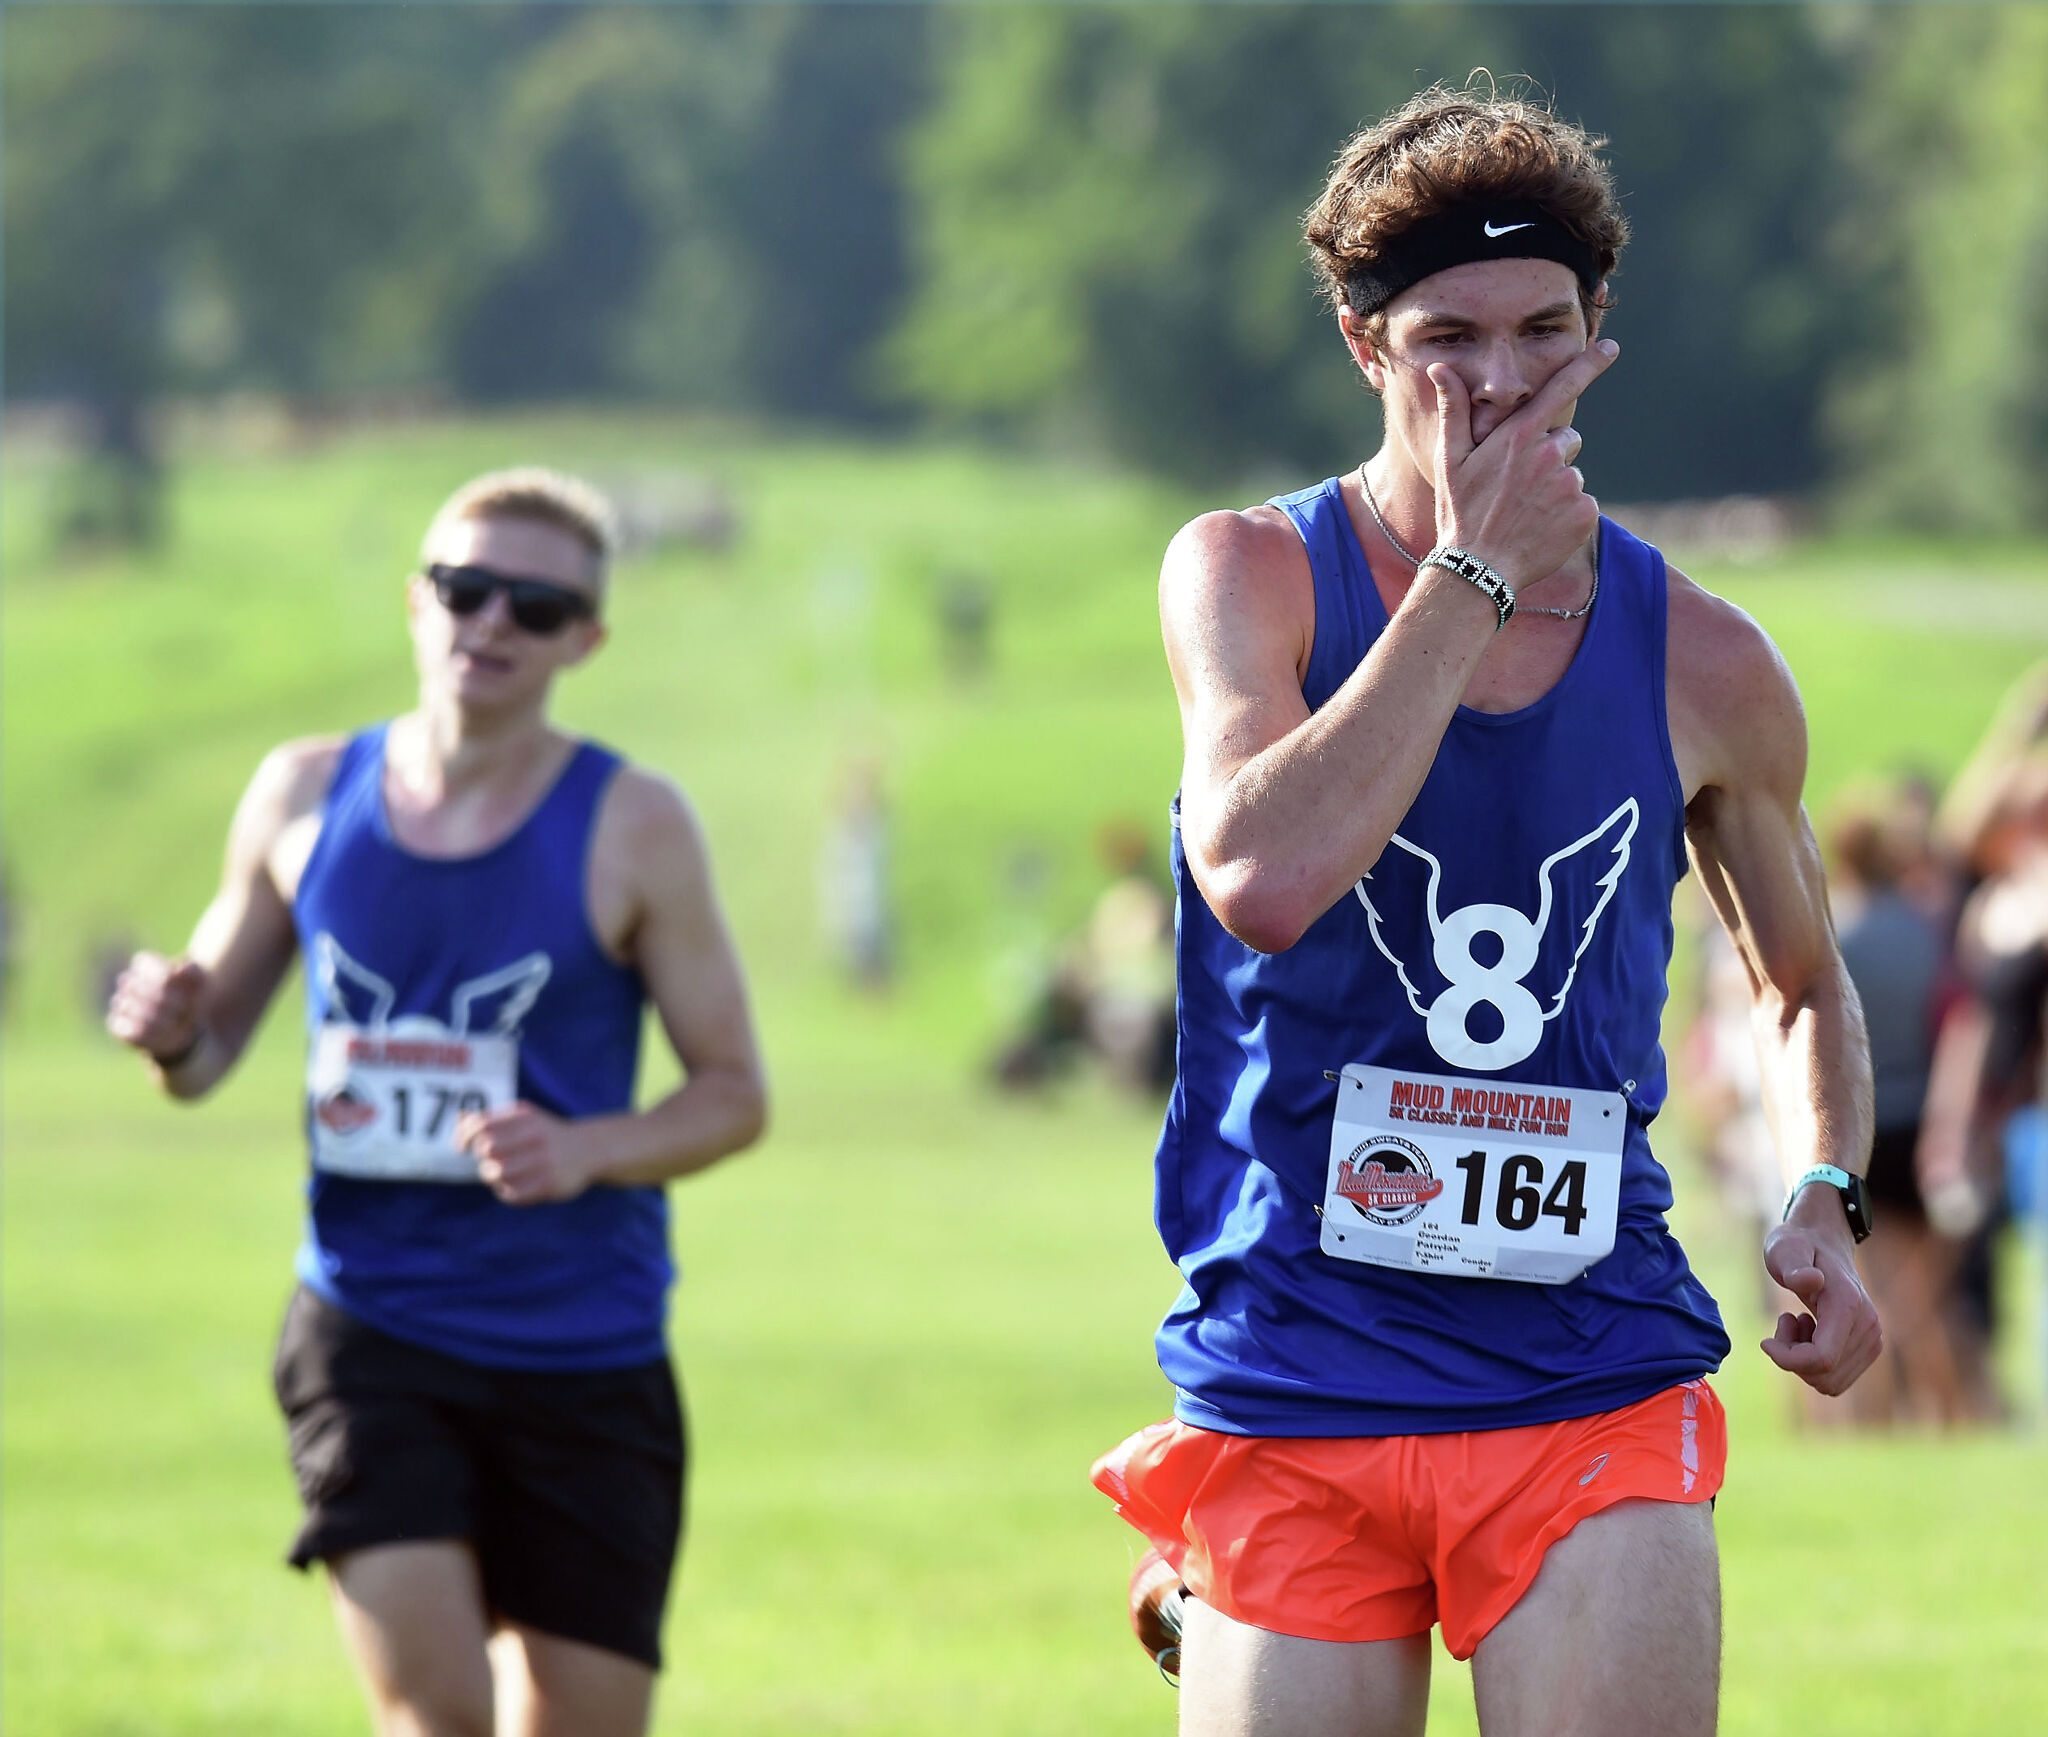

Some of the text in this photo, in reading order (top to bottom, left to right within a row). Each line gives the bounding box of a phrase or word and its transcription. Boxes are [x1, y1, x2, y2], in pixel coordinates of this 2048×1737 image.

[1427, 903, 1544, 1071] 8
[1389, 1105, 1569, 1137] 5K CLASSIC AND MILE FUN RUN
[1390, 1080, 1572, 1123] MUD MOUNTAIN
[1382, 1192, 1417, 1203] CLASSIC
[1455, 1150, 1587, 1237] 164
